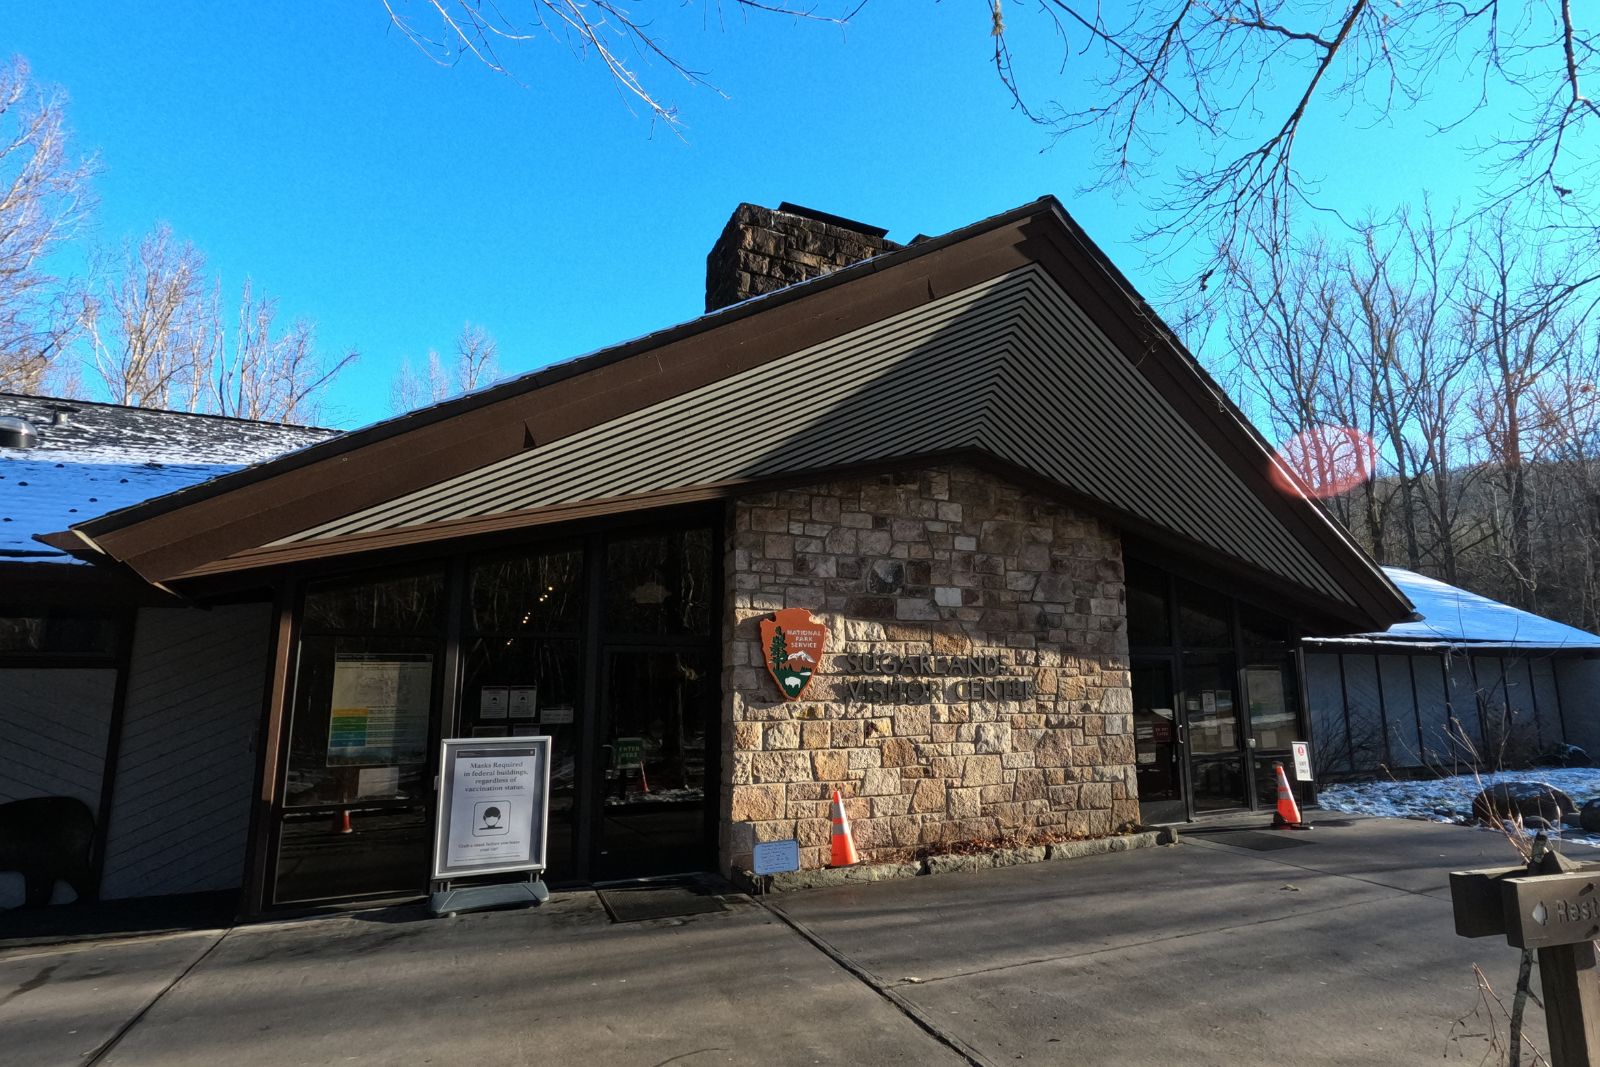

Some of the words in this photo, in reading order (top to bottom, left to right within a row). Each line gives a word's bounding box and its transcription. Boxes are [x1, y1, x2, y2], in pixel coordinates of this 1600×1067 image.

[846, 652, 1011, 675] SUGARLANDS
[847, 679, 942, 701] VISITOR
[955, 678, 1036, 701] CENTER
[496, 769, 528, 777] buildings,
